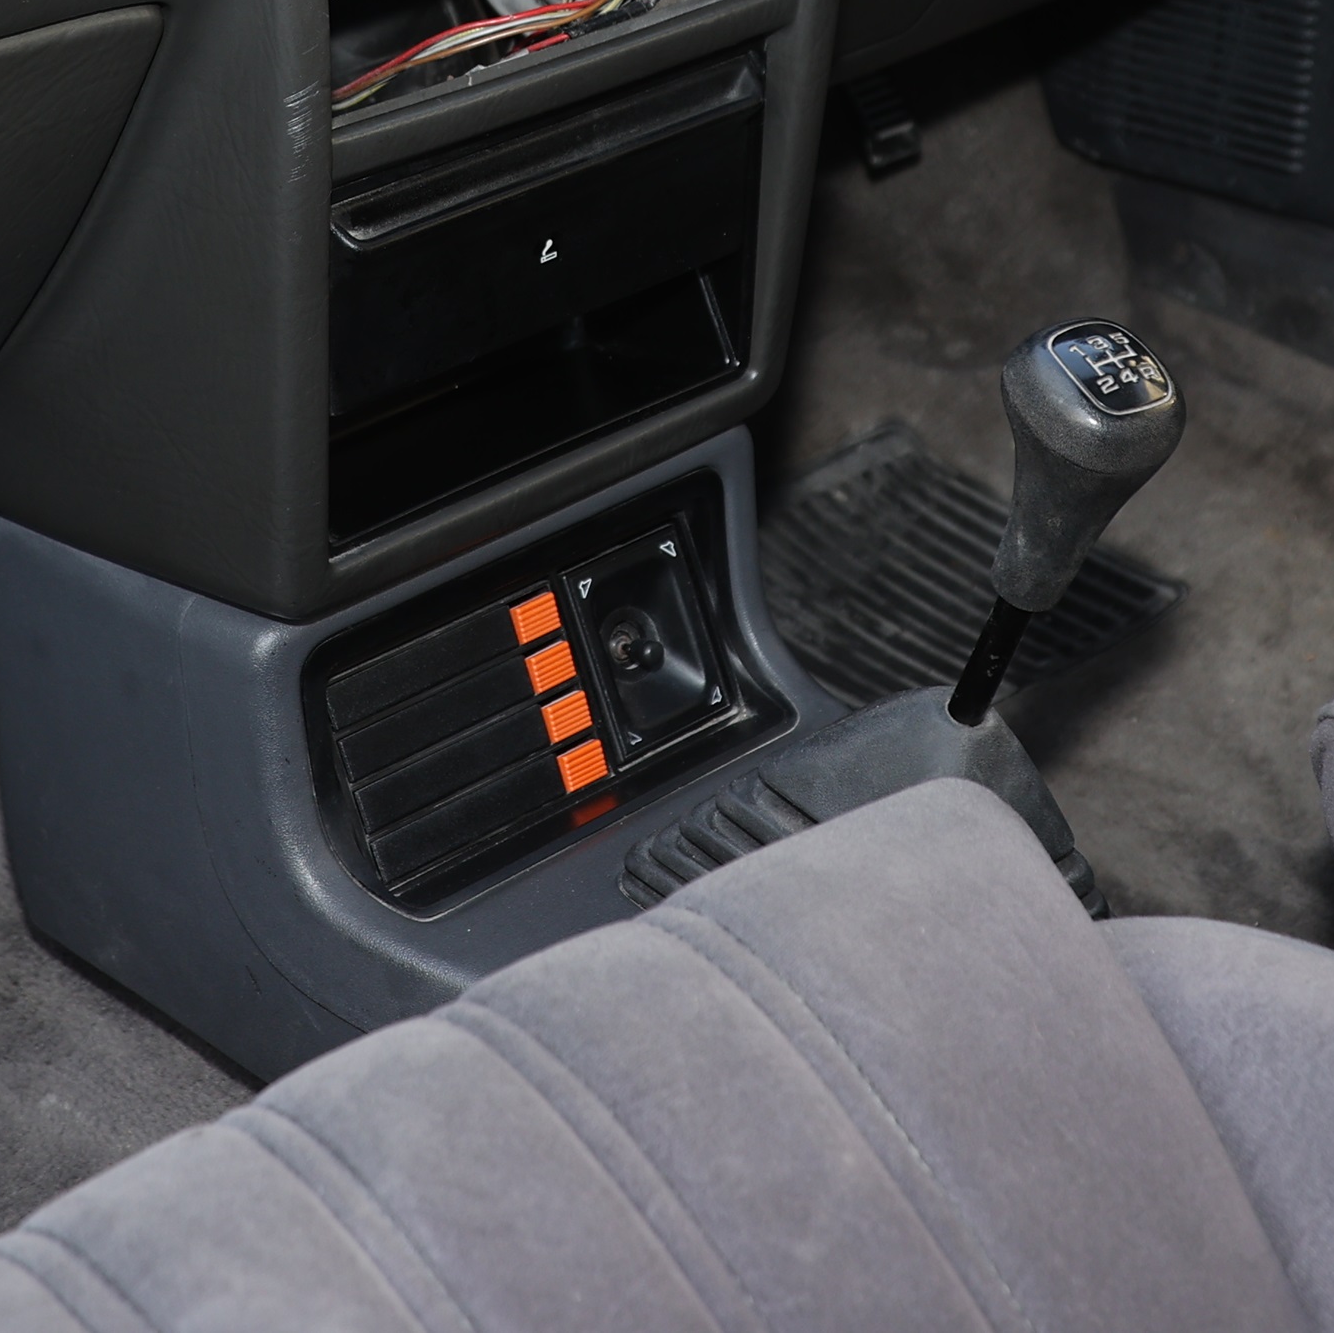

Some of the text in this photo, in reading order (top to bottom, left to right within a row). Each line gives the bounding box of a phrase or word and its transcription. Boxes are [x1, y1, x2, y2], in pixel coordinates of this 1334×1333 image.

[1069, 332, 1130, 356] 1 3 5
[1096, 362, 1162, 395] 2 4 R
